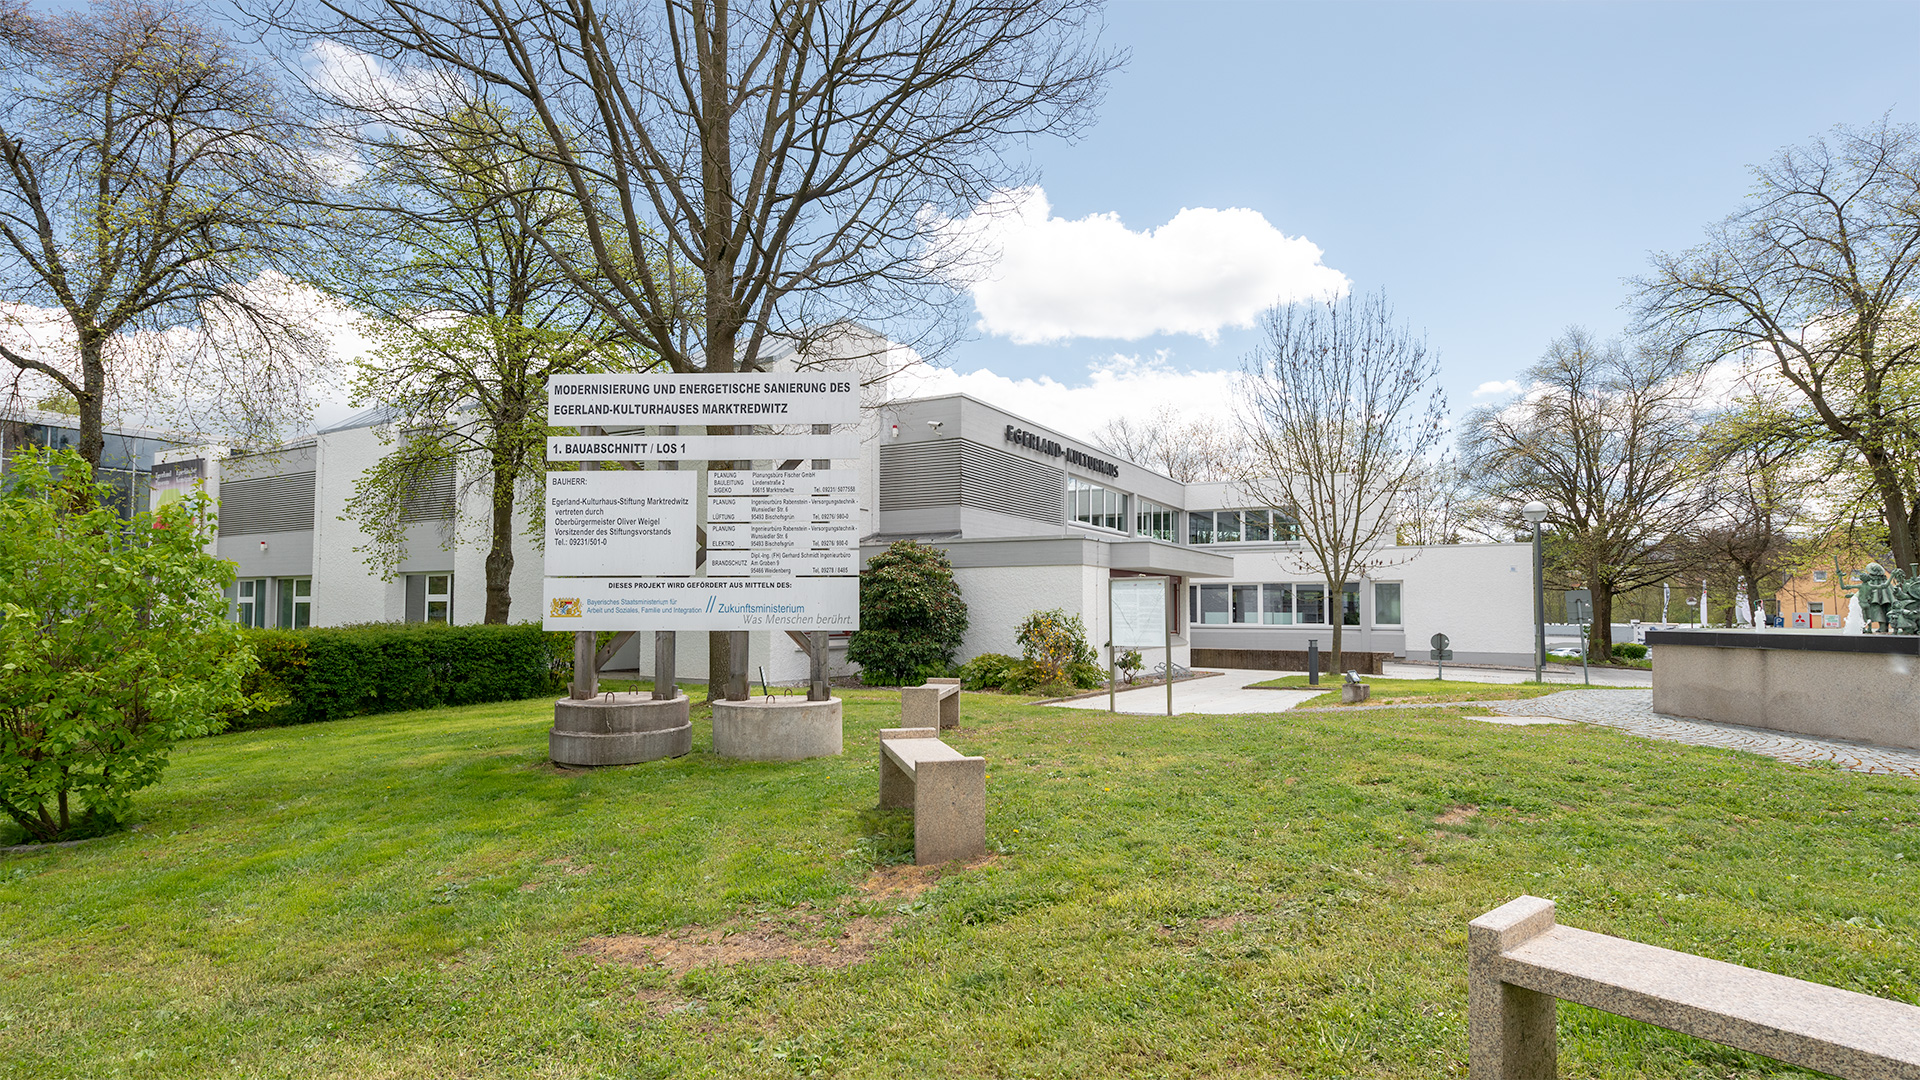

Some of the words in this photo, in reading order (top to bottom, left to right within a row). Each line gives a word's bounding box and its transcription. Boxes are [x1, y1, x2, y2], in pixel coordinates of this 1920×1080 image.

[554, 384, 650, 395] MODERNISIERUNG
[653, 383, 676, 394] UND
[679, 383, 760, 394] ENERGETISCHE
[764, 383, 827, 394] SANIERUNG
[830, 382, 850, 393] DES
[554, 404, 699, 415] EGERLAND-KULTURHAUSES
[702, 404, 788, 414] MARKTREDWITZ
[553, 444, 562, 454] 1.
[565, 444, 647, 454] BAUABSCHNITT
[650, 443, 654, 454] /
[656, 443, 678, 453] LOS
[681, 443, 686, 453] 1
[1005, 425, 1119, 478] EGERLAND-KULTURHAUS
[552, 498, 645, 506] Egerland-Kulturhaus-Stiftung
[555, 518, 615, 527] Oberbürgermeister
[638, 518, 660, 527] Weigel
[609, 528, 671, 537] Stiftungsvorstands
[674, 607, 702, 615] Integration
[718, 603, 805, 613] Zukunftsministerium
[743, 614, 762, 624] Was
[765, 614, 814, 624] Menschen
[816, 614, 853, 624] berührt.
